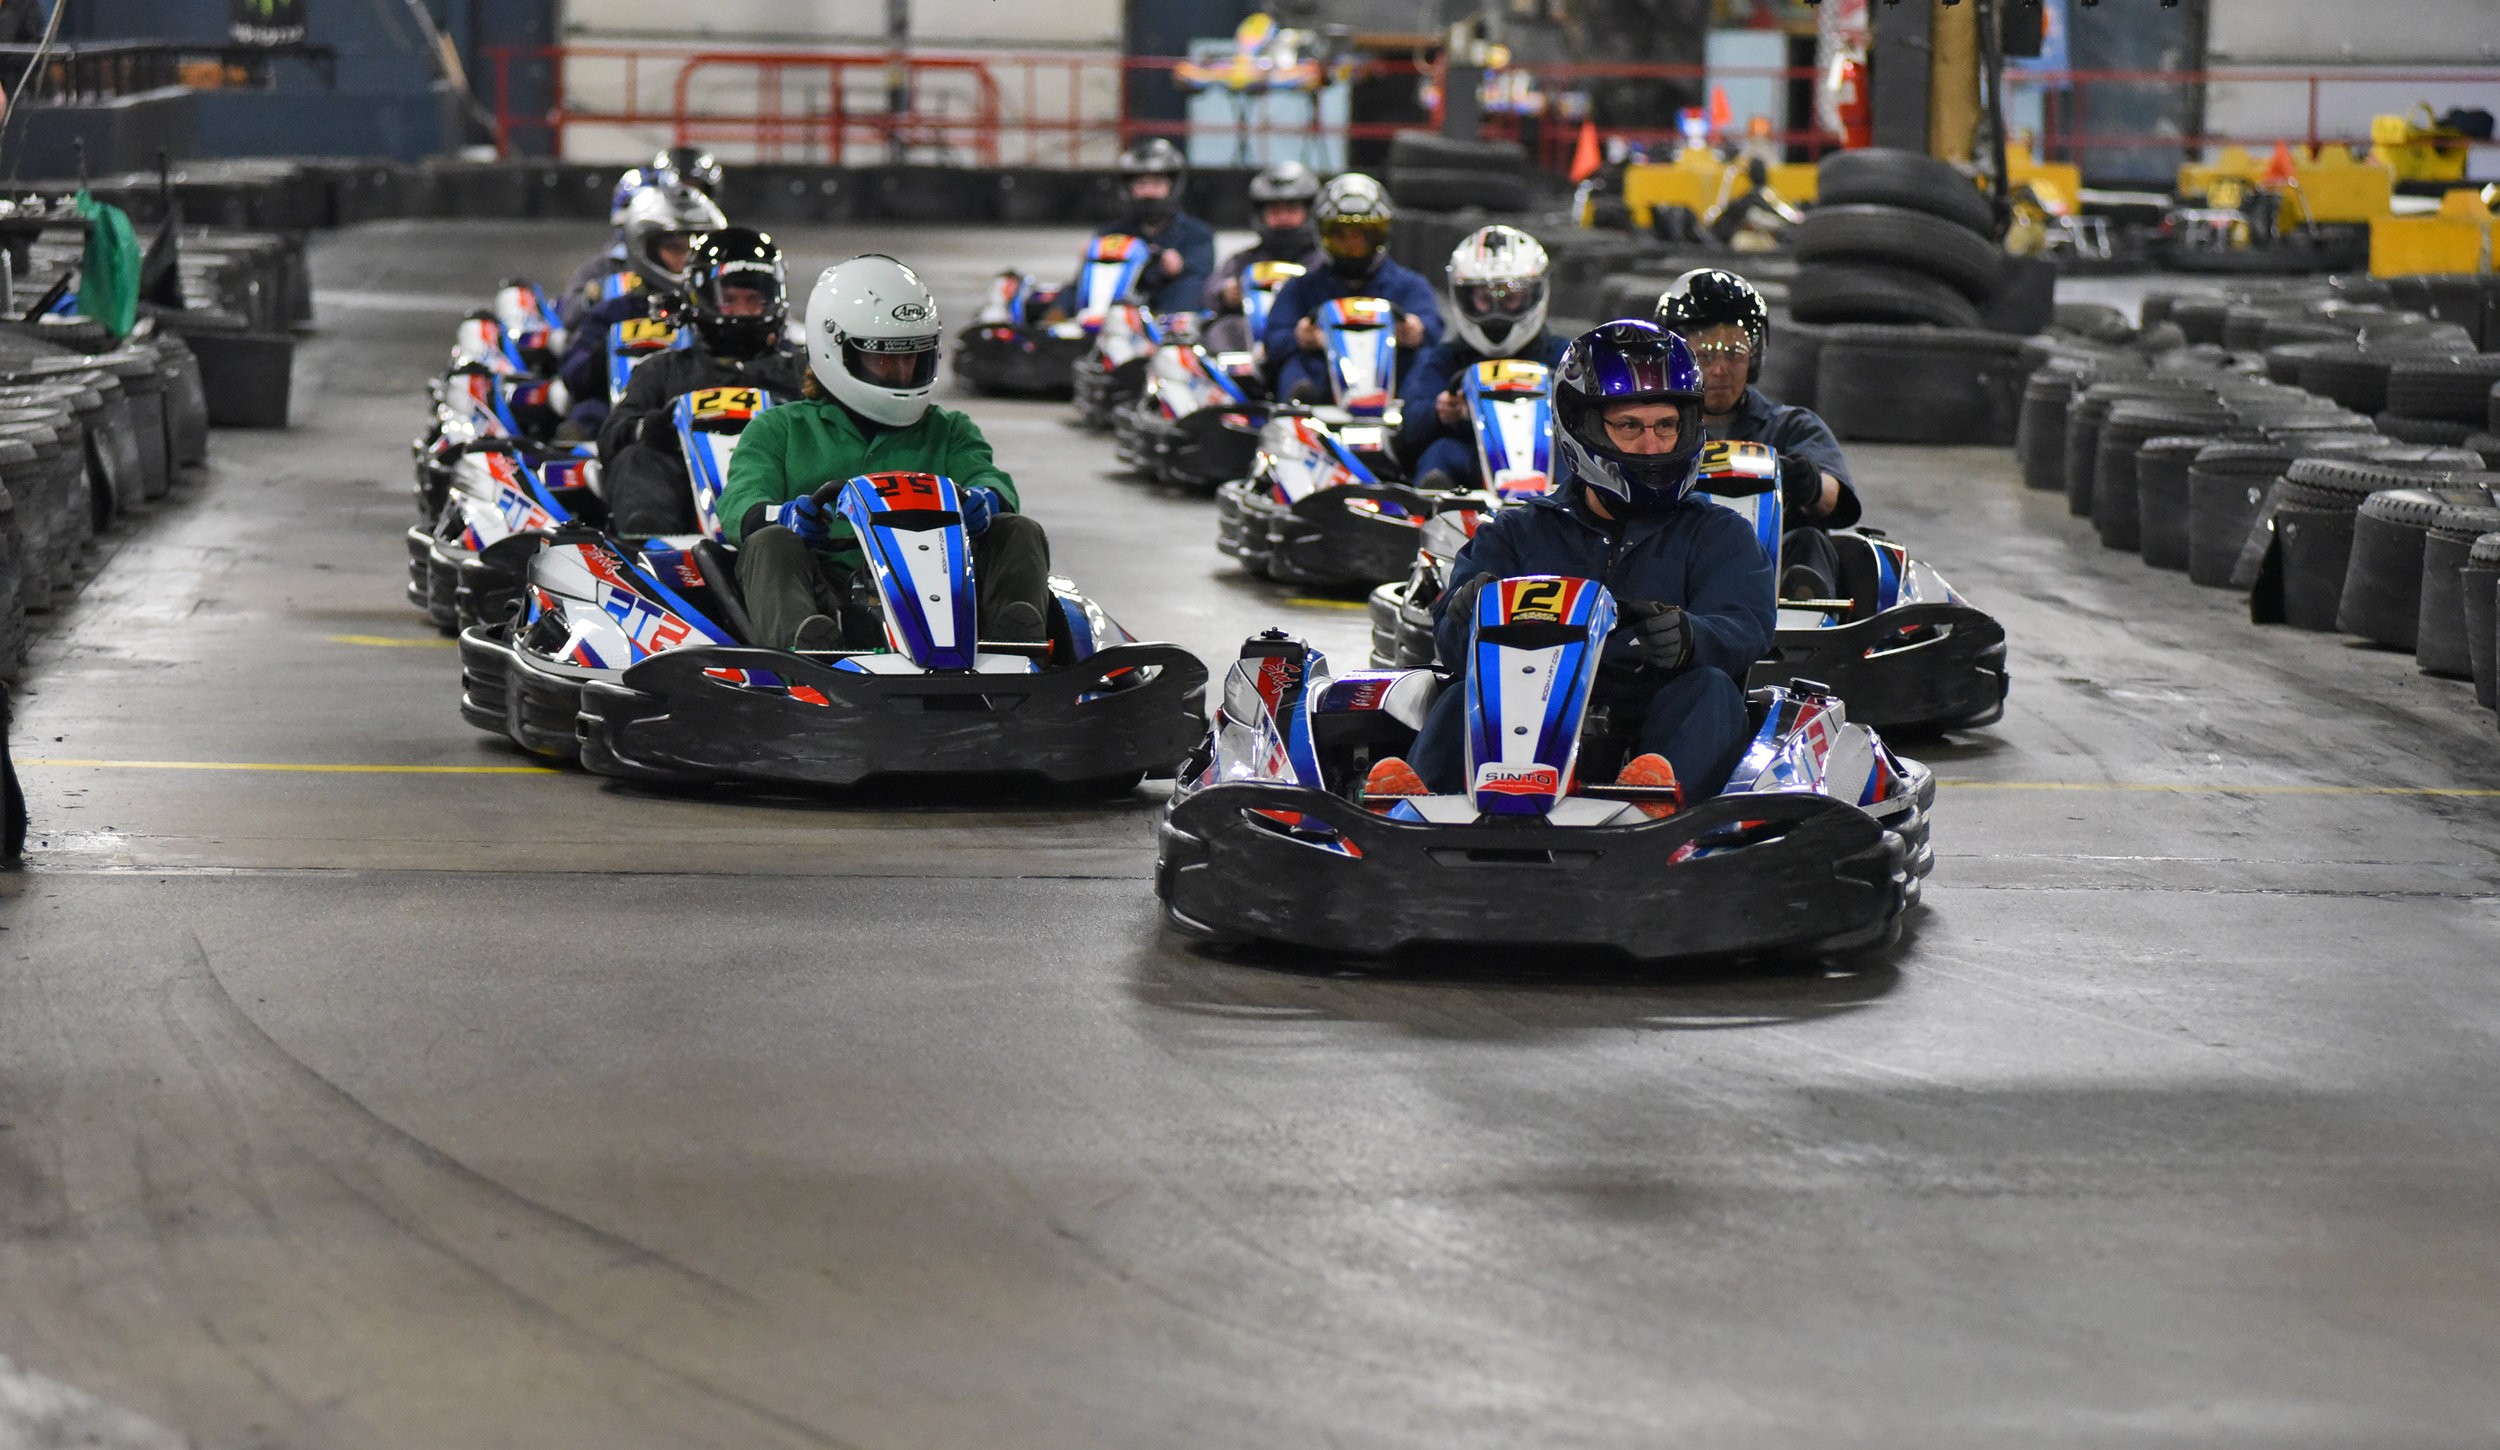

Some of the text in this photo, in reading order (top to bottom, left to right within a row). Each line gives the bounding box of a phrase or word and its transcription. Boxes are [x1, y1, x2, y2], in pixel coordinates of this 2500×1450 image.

[697, 391, 757, 411] 24
[1518, 581, 1562, 610] 2
[1485, 772, 1551, 785] SINTO
